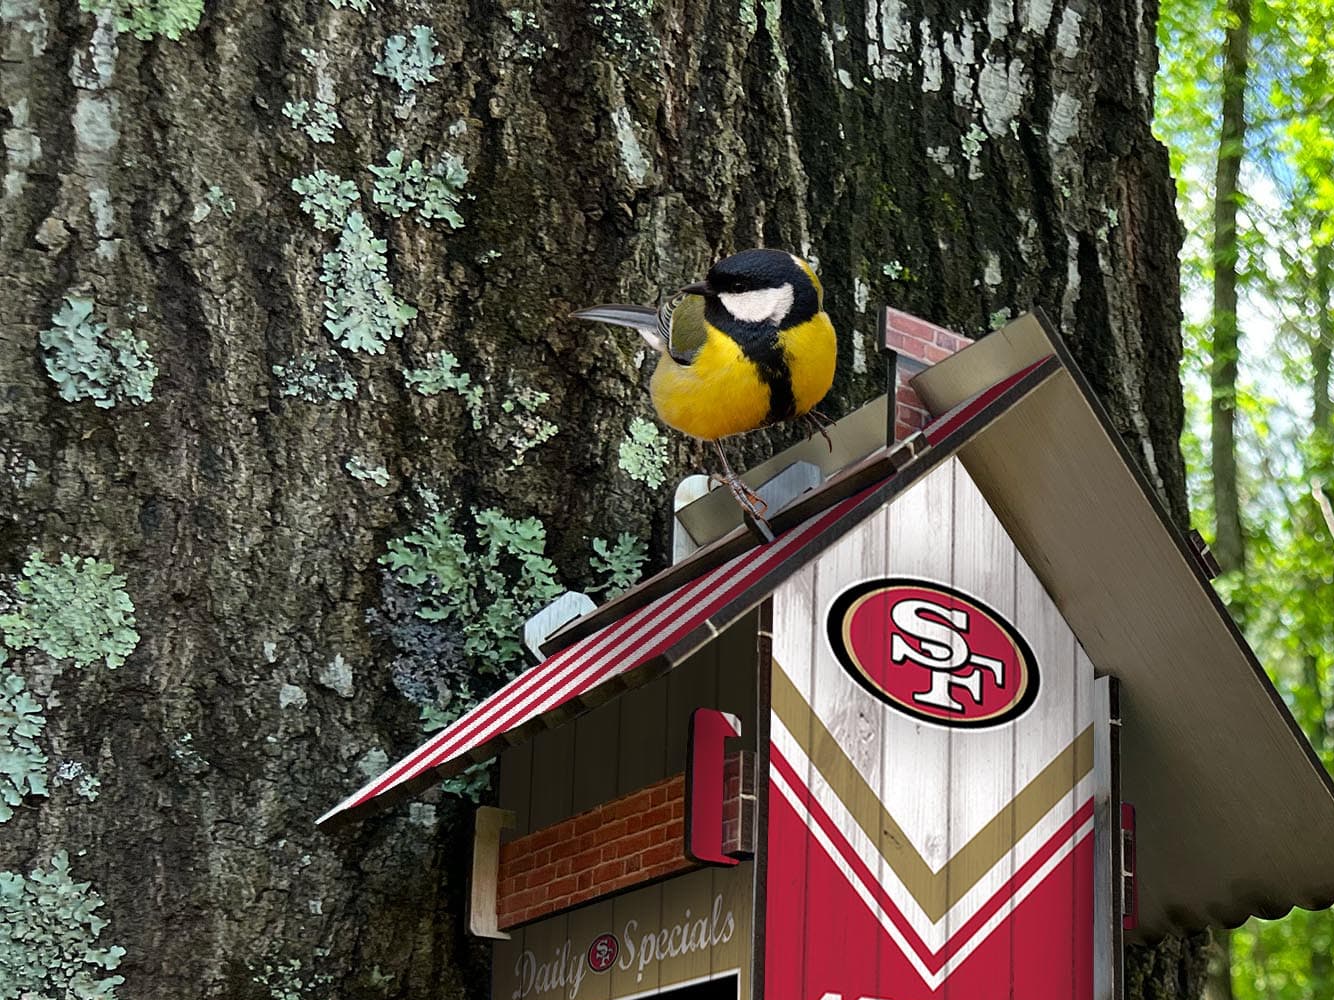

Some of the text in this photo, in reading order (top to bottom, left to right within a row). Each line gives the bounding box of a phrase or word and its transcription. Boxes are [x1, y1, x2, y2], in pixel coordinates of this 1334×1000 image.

[891, 598, 1005, 713] SF
[512, 939, 589, 1000] Daily
[618, 893, 736, 983] Specials
